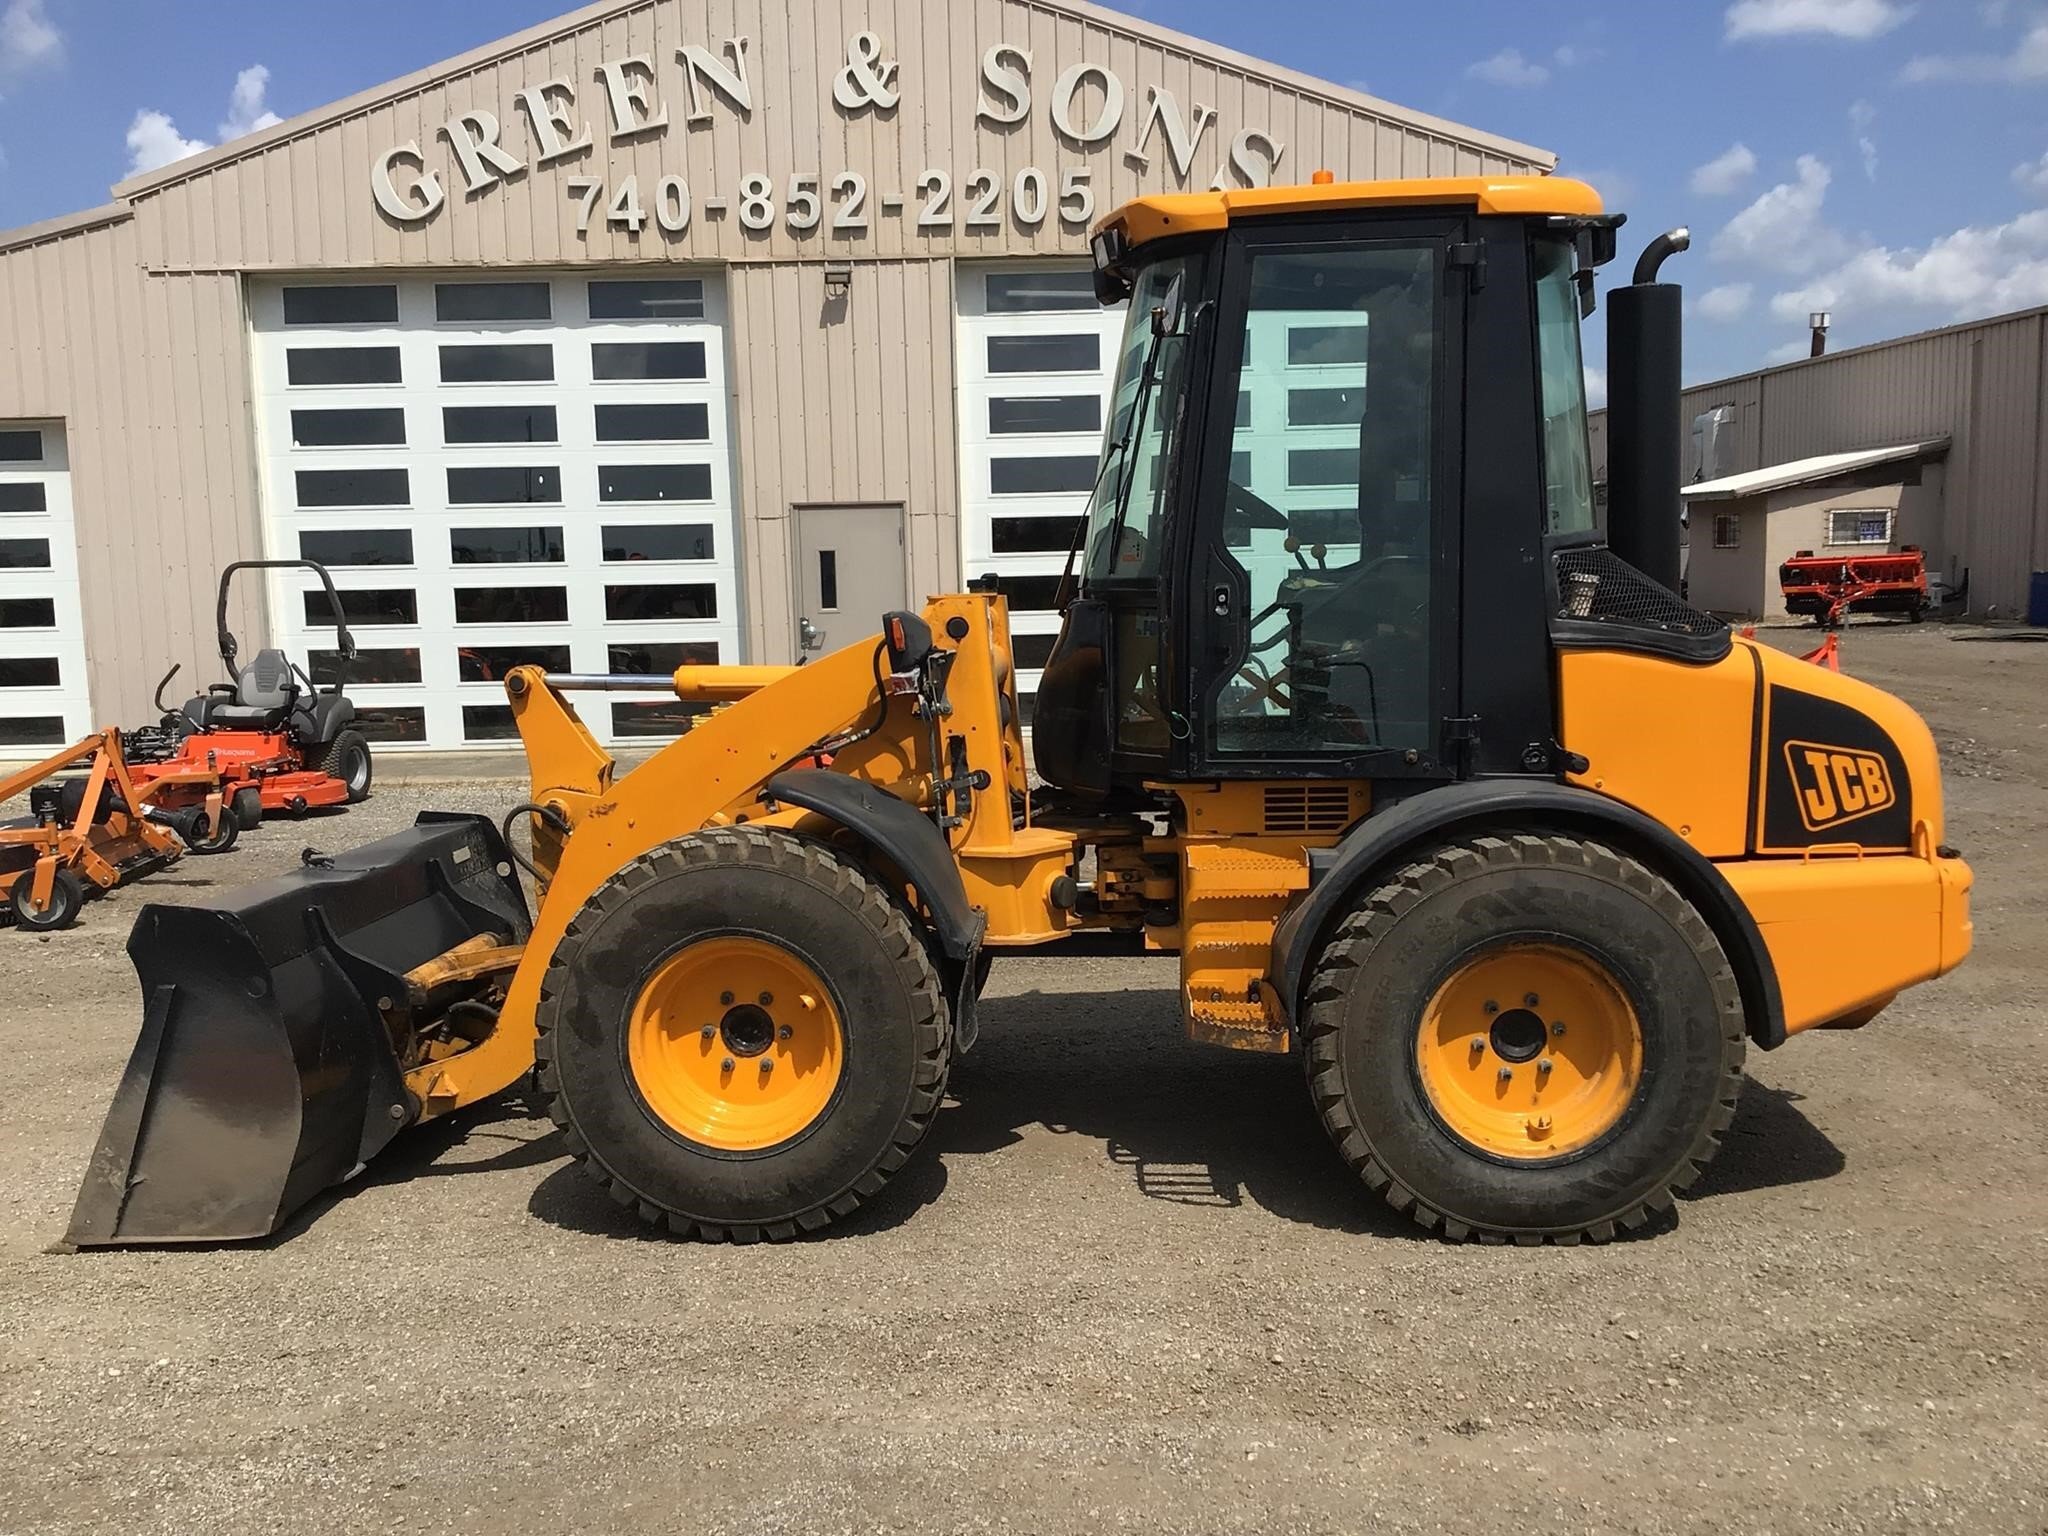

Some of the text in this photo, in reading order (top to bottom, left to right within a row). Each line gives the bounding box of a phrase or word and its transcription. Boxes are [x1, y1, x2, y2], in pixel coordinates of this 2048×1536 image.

[371, 31, 1286, 221] GREEN & SONS
[567, 166, 1095, 231] 740-852-2205
[1804, 751, 1888, 821] JCB
